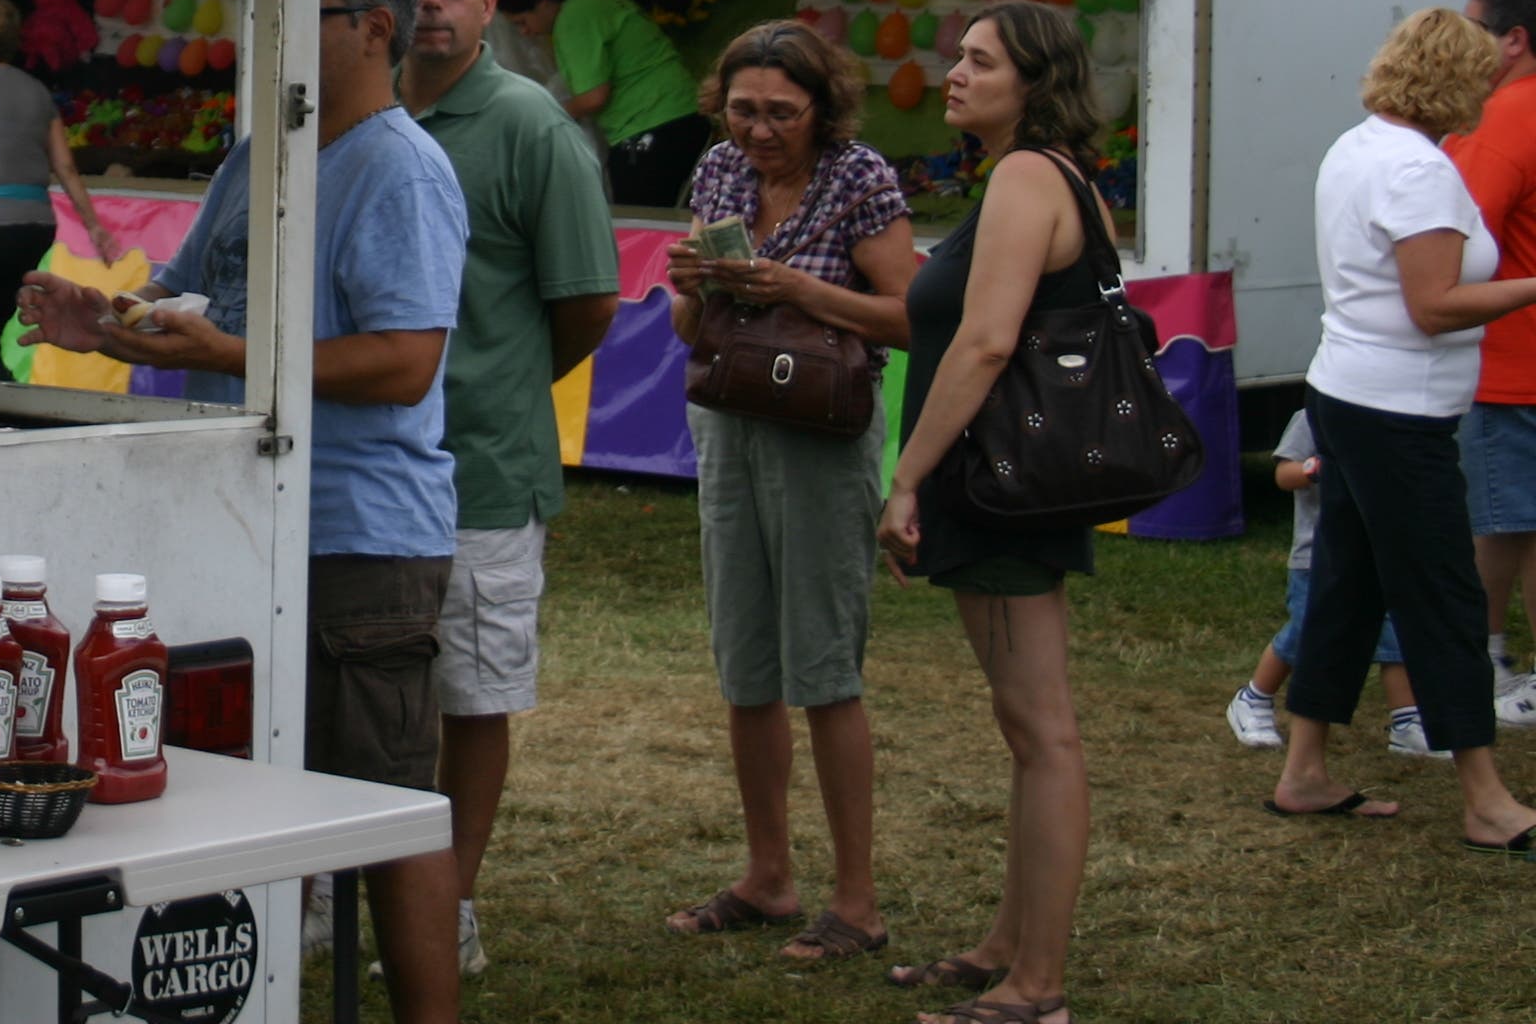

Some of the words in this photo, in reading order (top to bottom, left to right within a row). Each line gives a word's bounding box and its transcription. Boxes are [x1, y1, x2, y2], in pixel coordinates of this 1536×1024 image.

[20, 676, 42, 687] ATO
[131, 678, 154, 691] HEINZ
[126, 696, 157, 710] TOMATO
[127, 707, 156, 719] KETCHUP
[139, 922, 253, 967] WELLS
[143, 957, 251, 1001] CARGO
